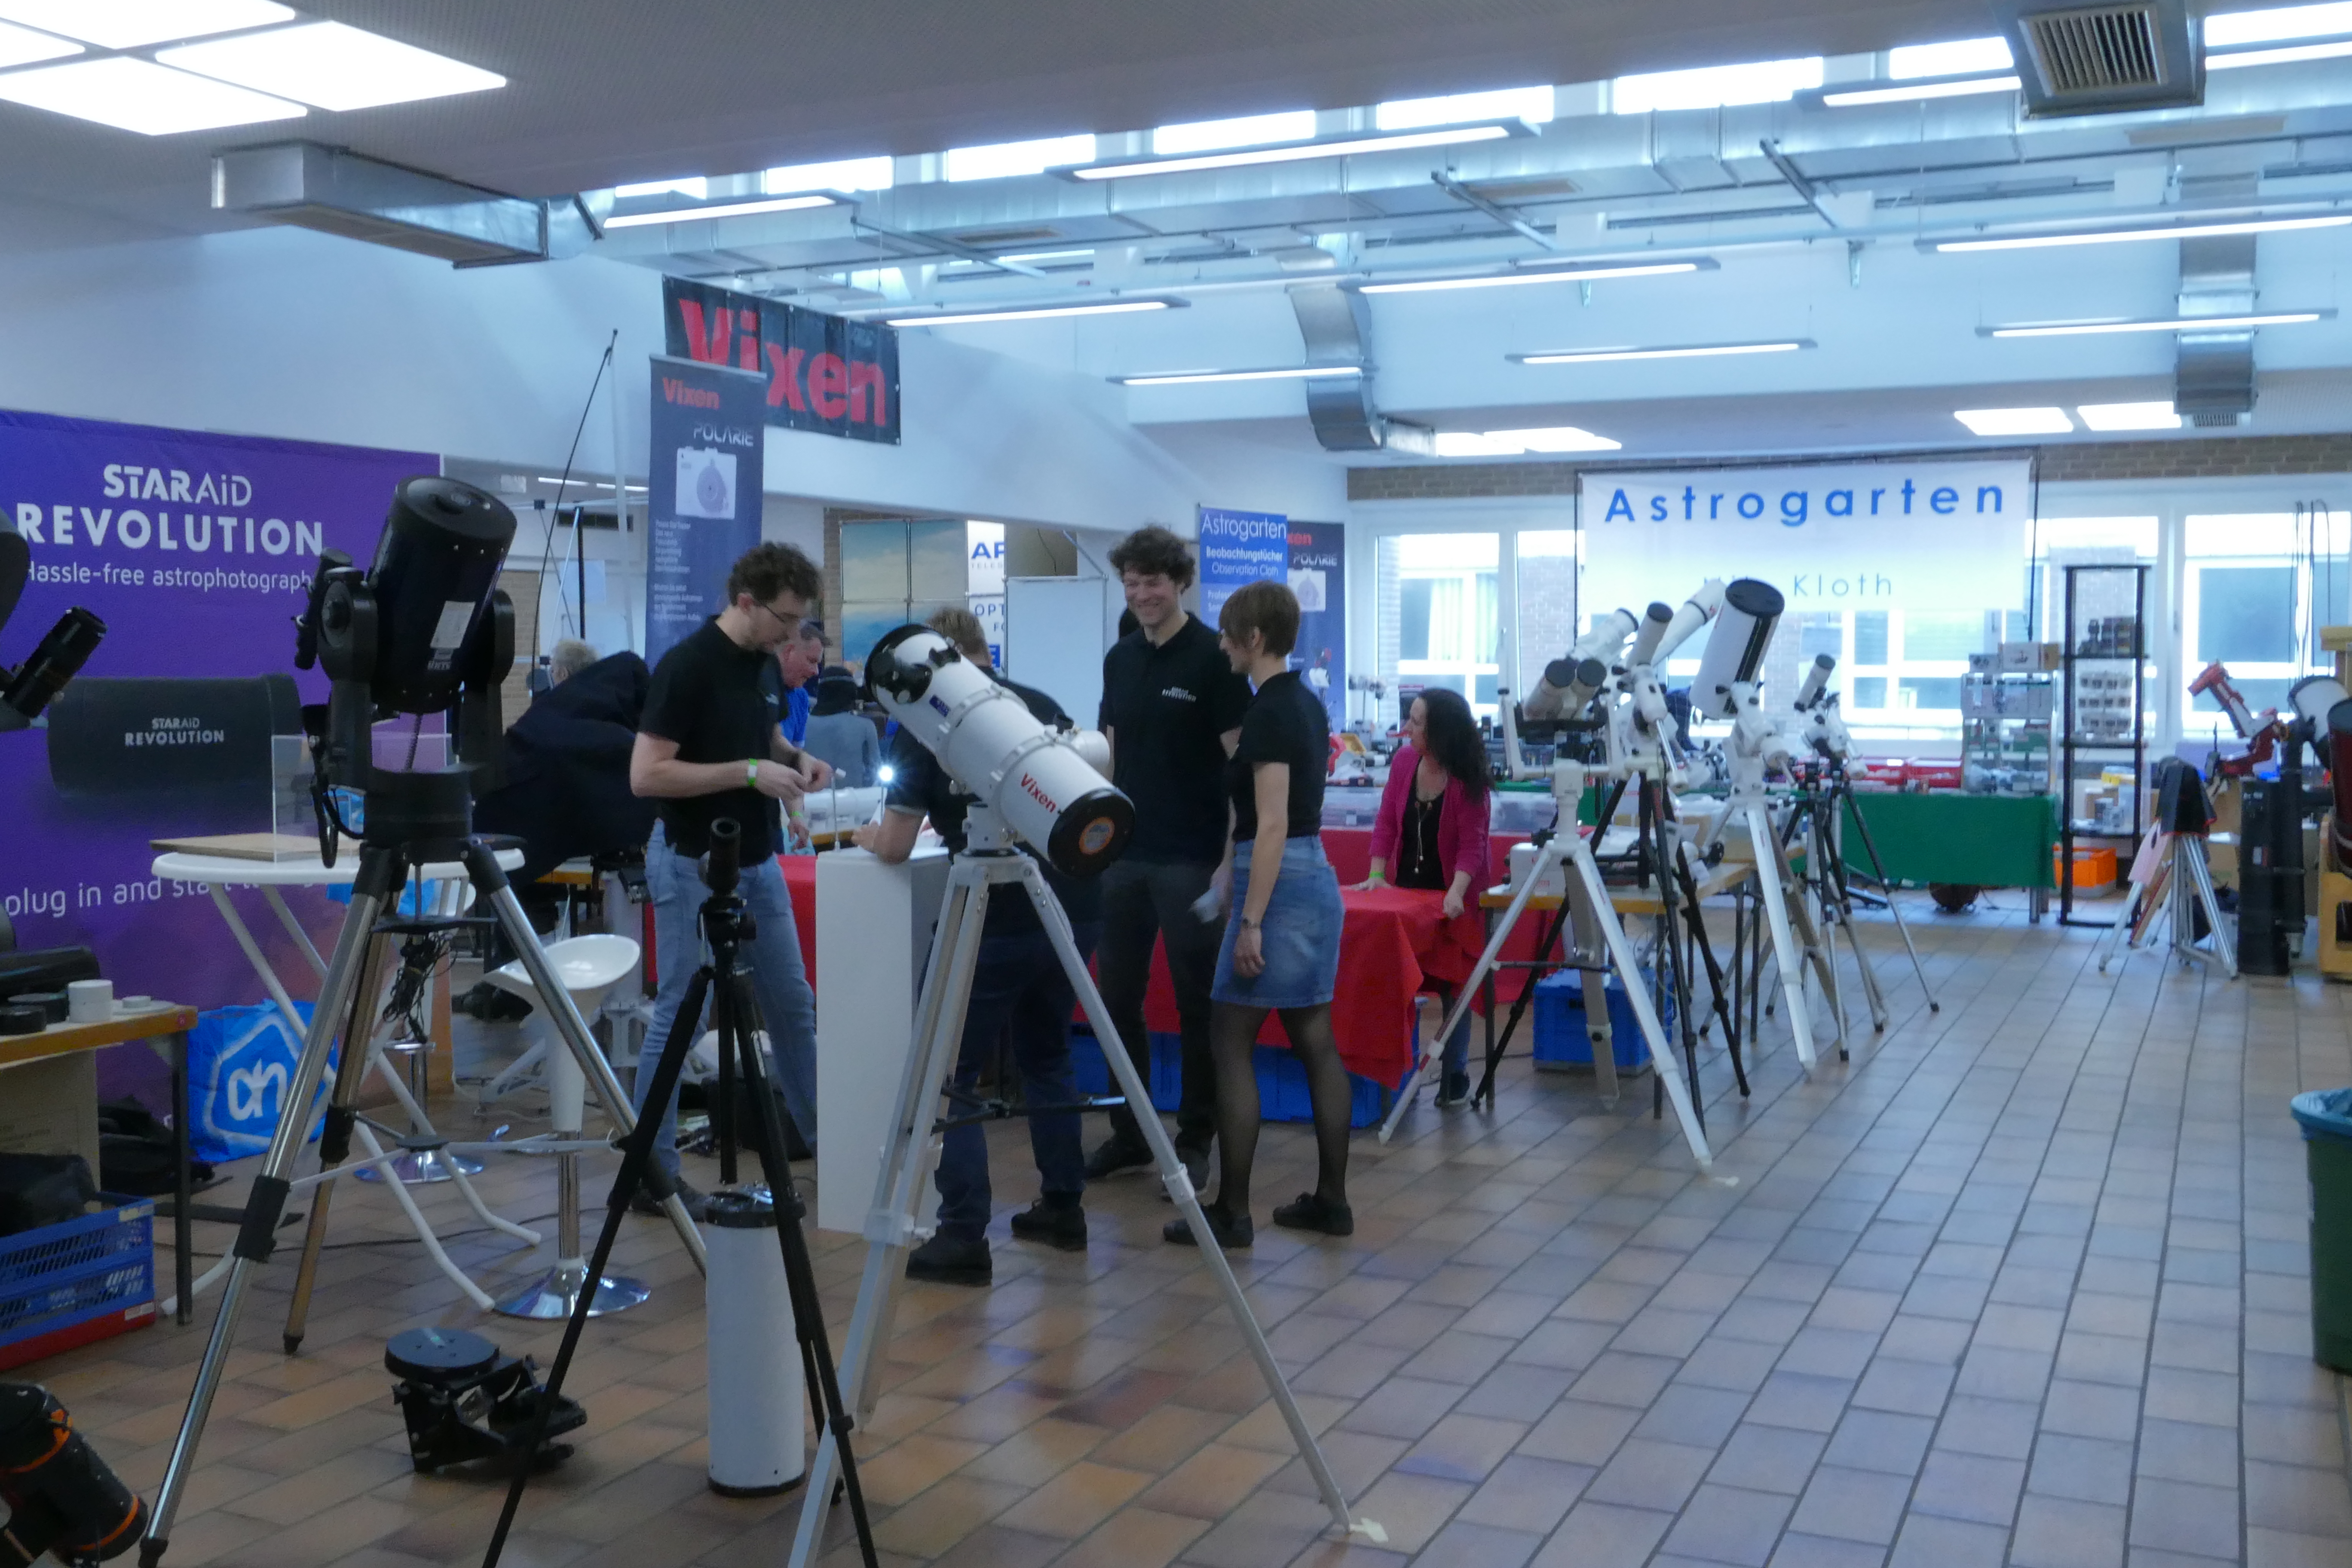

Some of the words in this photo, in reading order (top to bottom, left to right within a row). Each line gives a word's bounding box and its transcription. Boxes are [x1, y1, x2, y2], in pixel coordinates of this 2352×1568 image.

[679, 298, 885, 426] Vixen
[663, 377, 720, 409] Vixen
[1605, 478, 2003, 527] Astrogarten
[17, 503, 322, 555] REVOLUTION
[1201, 513, 1286, 542] Astrogarten
[153, 567, 314, 594] astrophotograph
[1794, 574, 1891, 597] Kloth
[125, 730, 224, 746] REVOLUTION
[1020, 772, 1057, 814] Vixen
[79, 882, 101, 908] in
[113, 876, 161, 904] and
